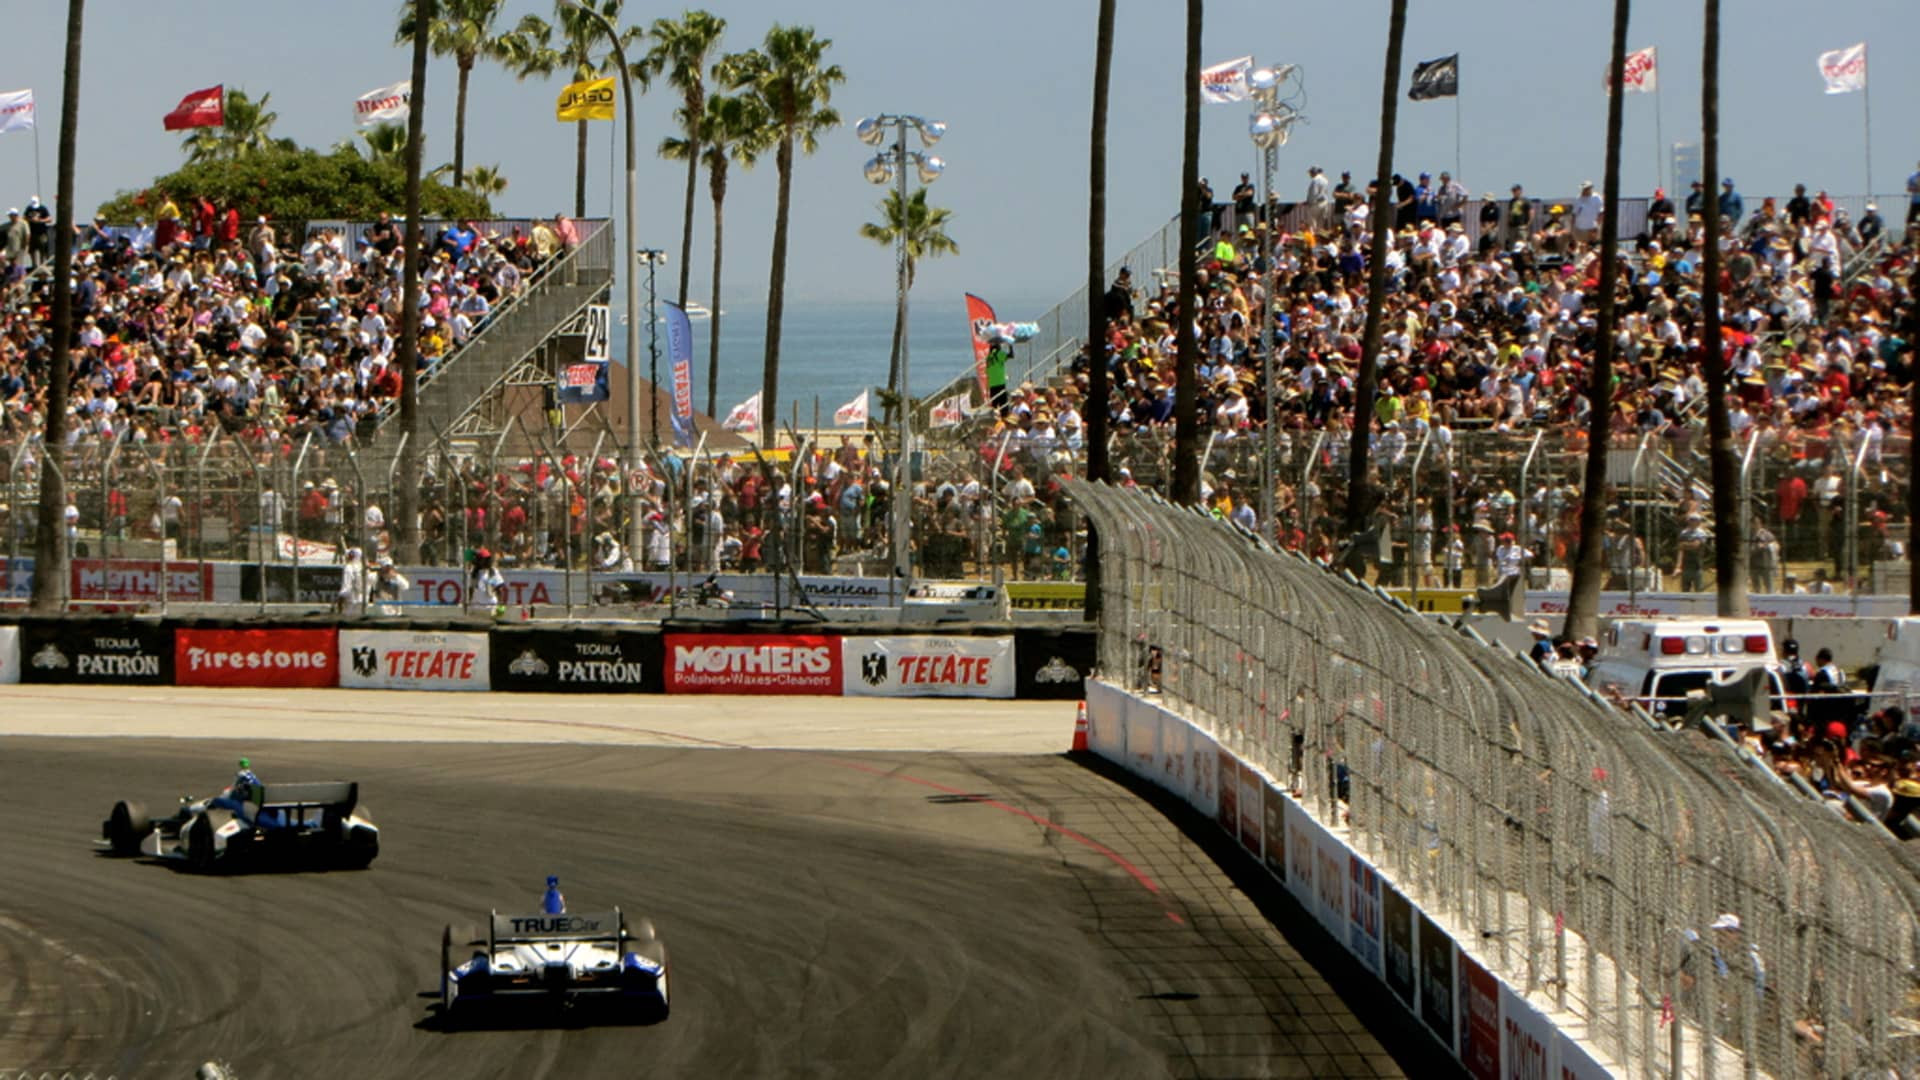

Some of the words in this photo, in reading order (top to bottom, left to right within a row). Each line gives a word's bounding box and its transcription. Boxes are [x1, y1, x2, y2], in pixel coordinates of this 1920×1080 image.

[587, 307, 608, 358] 24
[80, 569, 200, 593] MOTHERS
[417, 579, 552, 606] TOTA
[799, 581, 879, 596] merican
[95, 637, 141, 649] TEQUILA
[576, 643, 622, 655] TEQUILA
[77, 651, 160, 676] PATRÓN
[187, 647, 327, 671] Firestone
[384, 649, 477, 680] TECATE
[558, 657, 642, 684] PATRÓN
[674, 645, 831, 673] MOTHERS
[897, 651, 991, 686] TECATE
[510, 917, 600, 933] TRUECar
